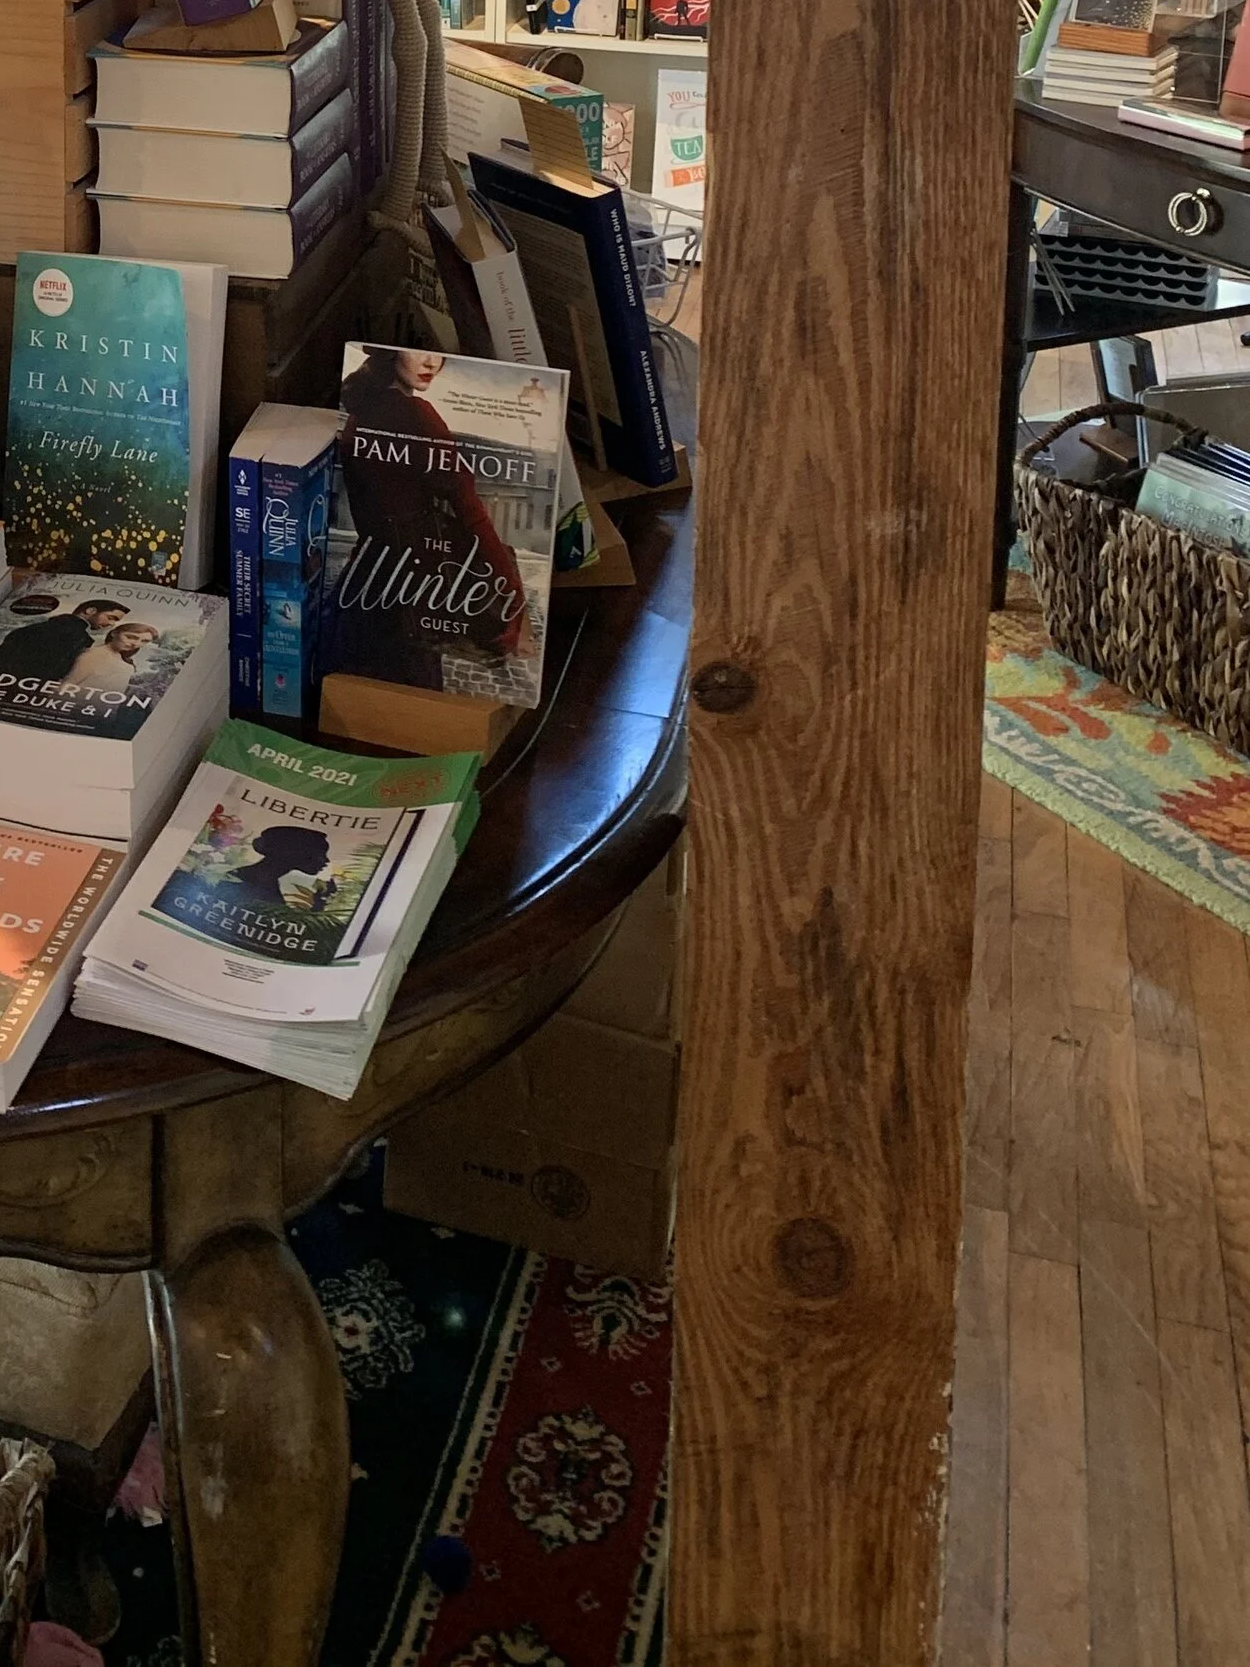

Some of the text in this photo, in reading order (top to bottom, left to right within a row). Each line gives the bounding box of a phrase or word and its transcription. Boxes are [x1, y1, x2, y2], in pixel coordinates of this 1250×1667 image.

[673, 139, 702, 156] TEA
[610, 209, 620, 232] WHO
[616, 245, 630, 271] MAUD
[40, 280, 67, 291] NETFLIX
[29, 328, 178, 364] KRISTIN
[27, 371, 179, 407] HANNAH
[640, 350, 666, 450] ALEXANDRA ANDREWS
[39, 431, 158, 463] Firefly Lane
[353, 436, 412, 466] PAM
[424, 447, 537, 483] JENOFF
[235, 507, 250, 519] SE
[262, 496, 291, 557] QUINN
[285, 518, 297, 547] JULIA
[424, 537, 452, 553] THE
[52, 581, 190, 607] JULIA QUINN
[338, 534, 526, 622] Winter
[420, 616, 469, 635] GUEST
[12, 693, 76, 712] DUKE
[81, 705, 97, 716] &
[246, 743, 305, 774] APRIL
[308, 765, 359, 787] 2021
[240, 789, 381, 831] LIBERTIE
[91, 857, 115, 881] THE
[40, 886, 98, 965] WORLDWIDE
[174, 896, 319, 952] GREENIDGE
[198, 891, 307, 936] KAITLYN
